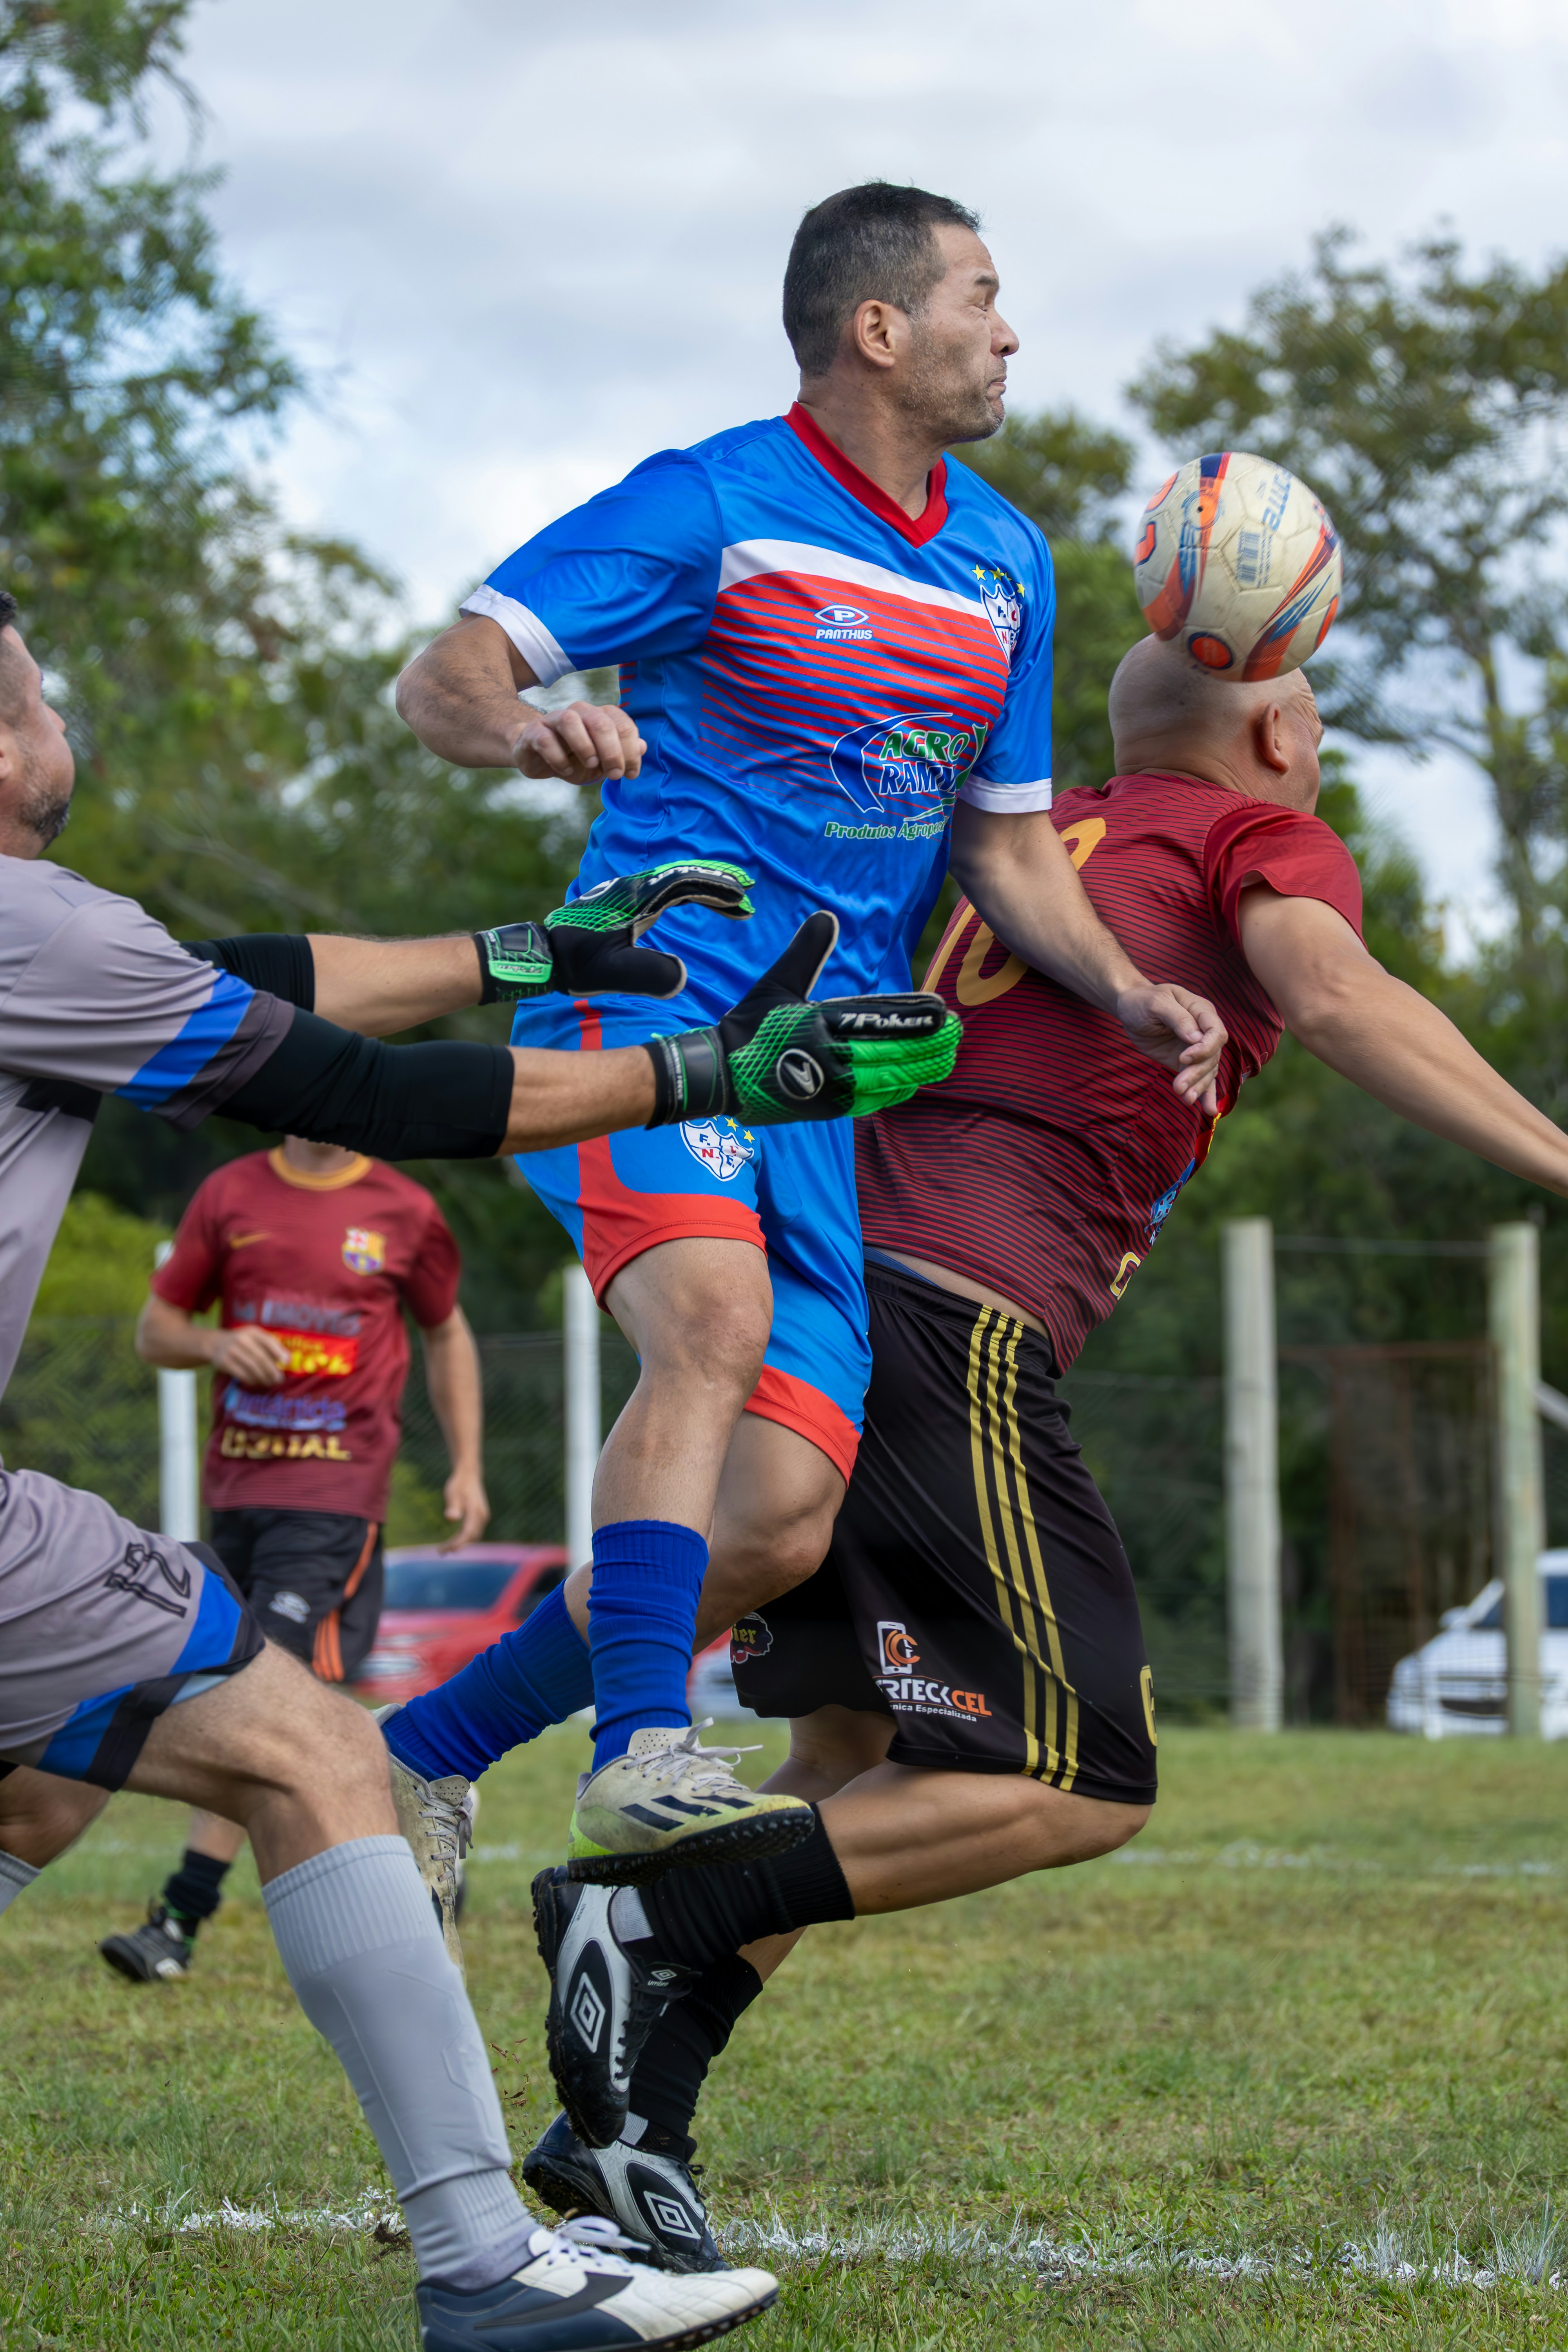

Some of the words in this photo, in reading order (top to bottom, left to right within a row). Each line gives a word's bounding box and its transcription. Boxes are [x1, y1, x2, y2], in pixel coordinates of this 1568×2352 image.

[815, 629, 873, 640] PANTHUS
[879, 729, 970, 762] AGRO
[824, 821, 896, 840] Produtos
[915, 1704, 977, 1722] Especializada
